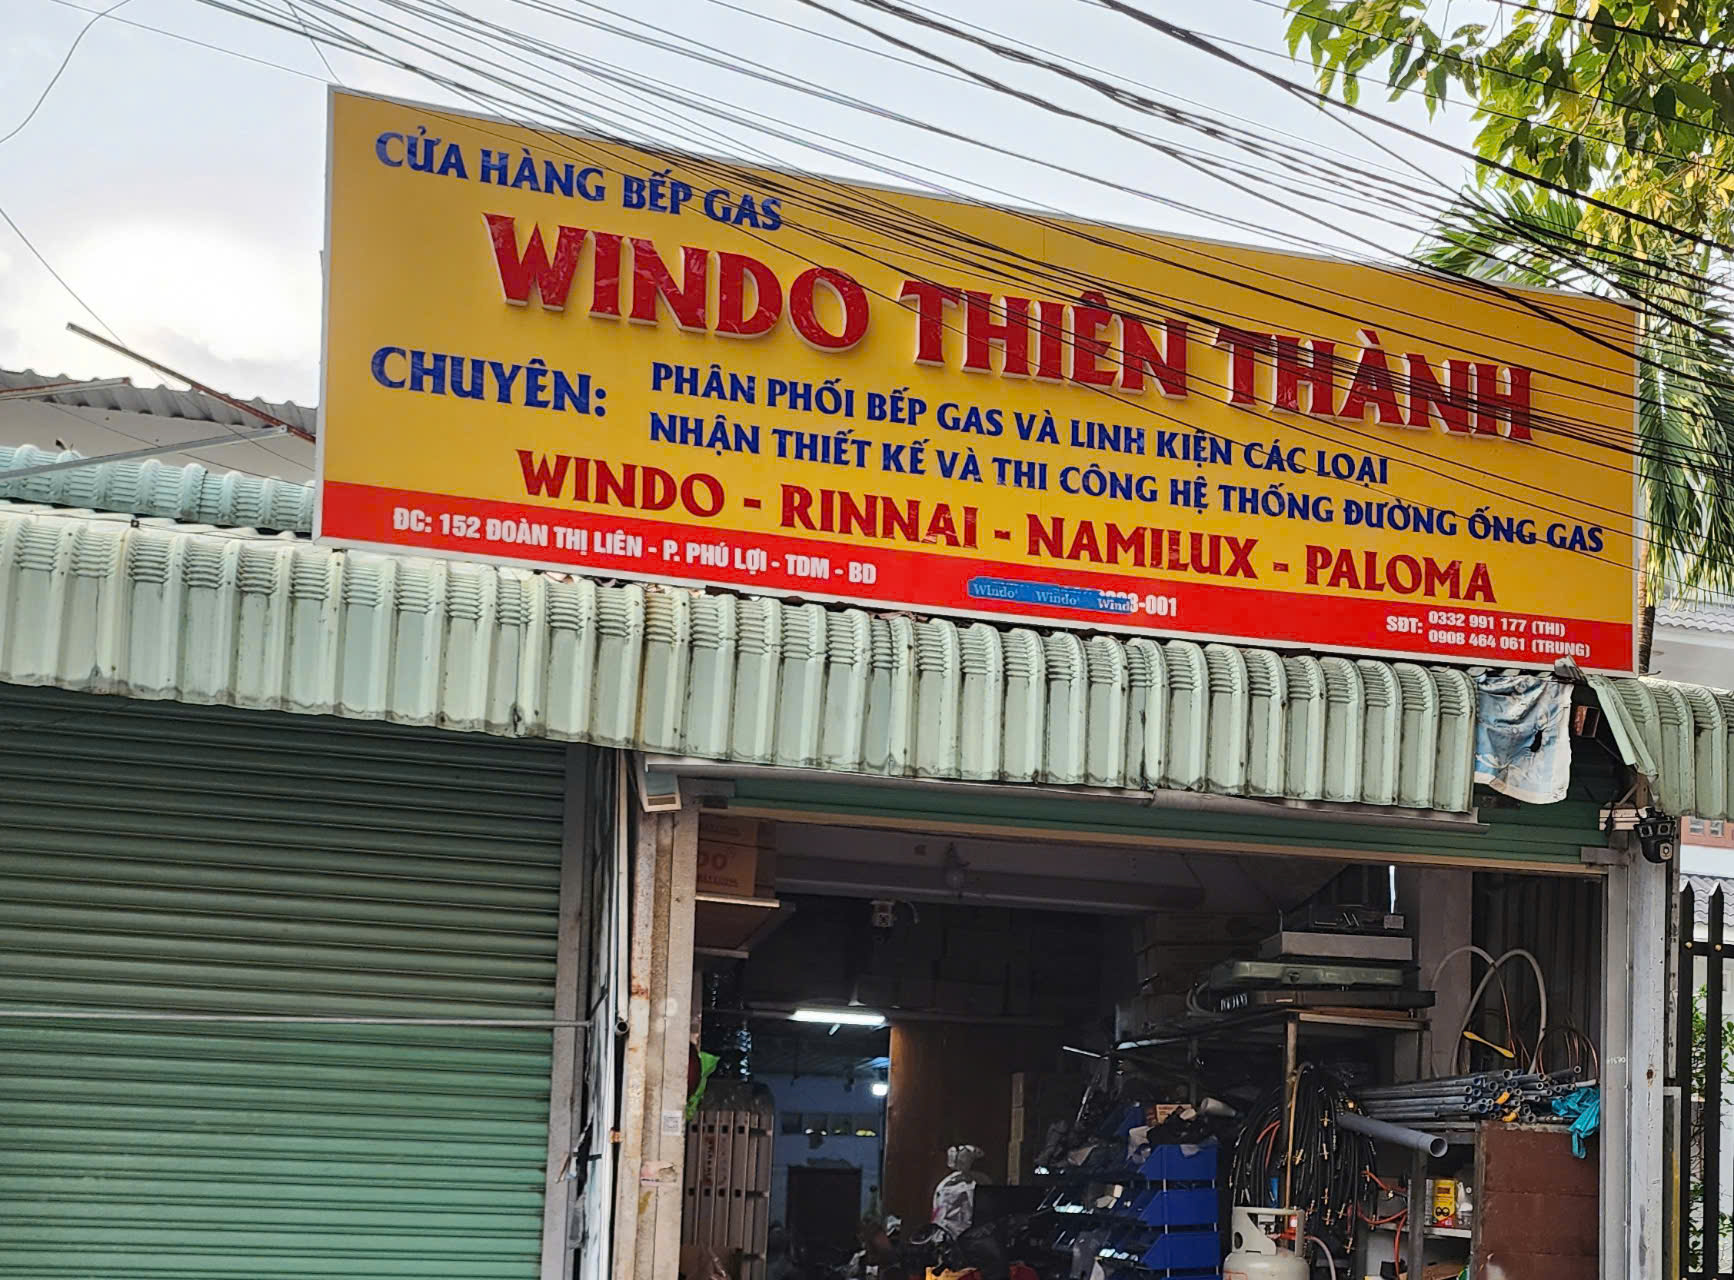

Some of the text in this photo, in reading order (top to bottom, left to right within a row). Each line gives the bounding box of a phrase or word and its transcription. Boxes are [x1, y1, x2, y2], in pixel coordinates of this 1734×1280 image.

[375, 126, 783, 231] CỬA HÀNG BẾP GAS
[482, 212, 1533, 441] WINDO THIÊN THÀNH
[370, 345, 607, 417] CHUYÊN:
[652, 361, 1388, 488] PHÂN PHỐI BẾP GAS VÀ LINH KIỆN CÁC LOẠI
[516, 449, 725, 517] WINDO
[780, 483, 978, 549] RINNAI
[1026, 513, 1259, 580] NAMILUX
[1305, 544, 1497, 604] PALOMA
[649, 412, 1604, 552] NHẬN THIẾT KẾ VÀ THI CÔNG HỆ THỐNG ĐƯỜNG ỐNG GAS
[393, 507, 432, 533] ĐC:
[439, 513, 481, 540] 152
[486, 517, 548, 547] ĐOÀN
[553, 526, 588, 556] THỊ
[593, 529, 642, 558] LIÊN
[662, 540, 681, 563] P.
[686, 541, 729, 567] PHÚ
[734, 547, 767, 575] LỢI
[785, 553, 830, 580] TDM
[848, 560, 877, 584] BD
[1386, 615, 1423, 634] SĐT:
[1428, 611, 1566, 637] 0332 991 177 (THI)
[1428, 630, 1590, 658] 0908 464 061 (TRUNG)
